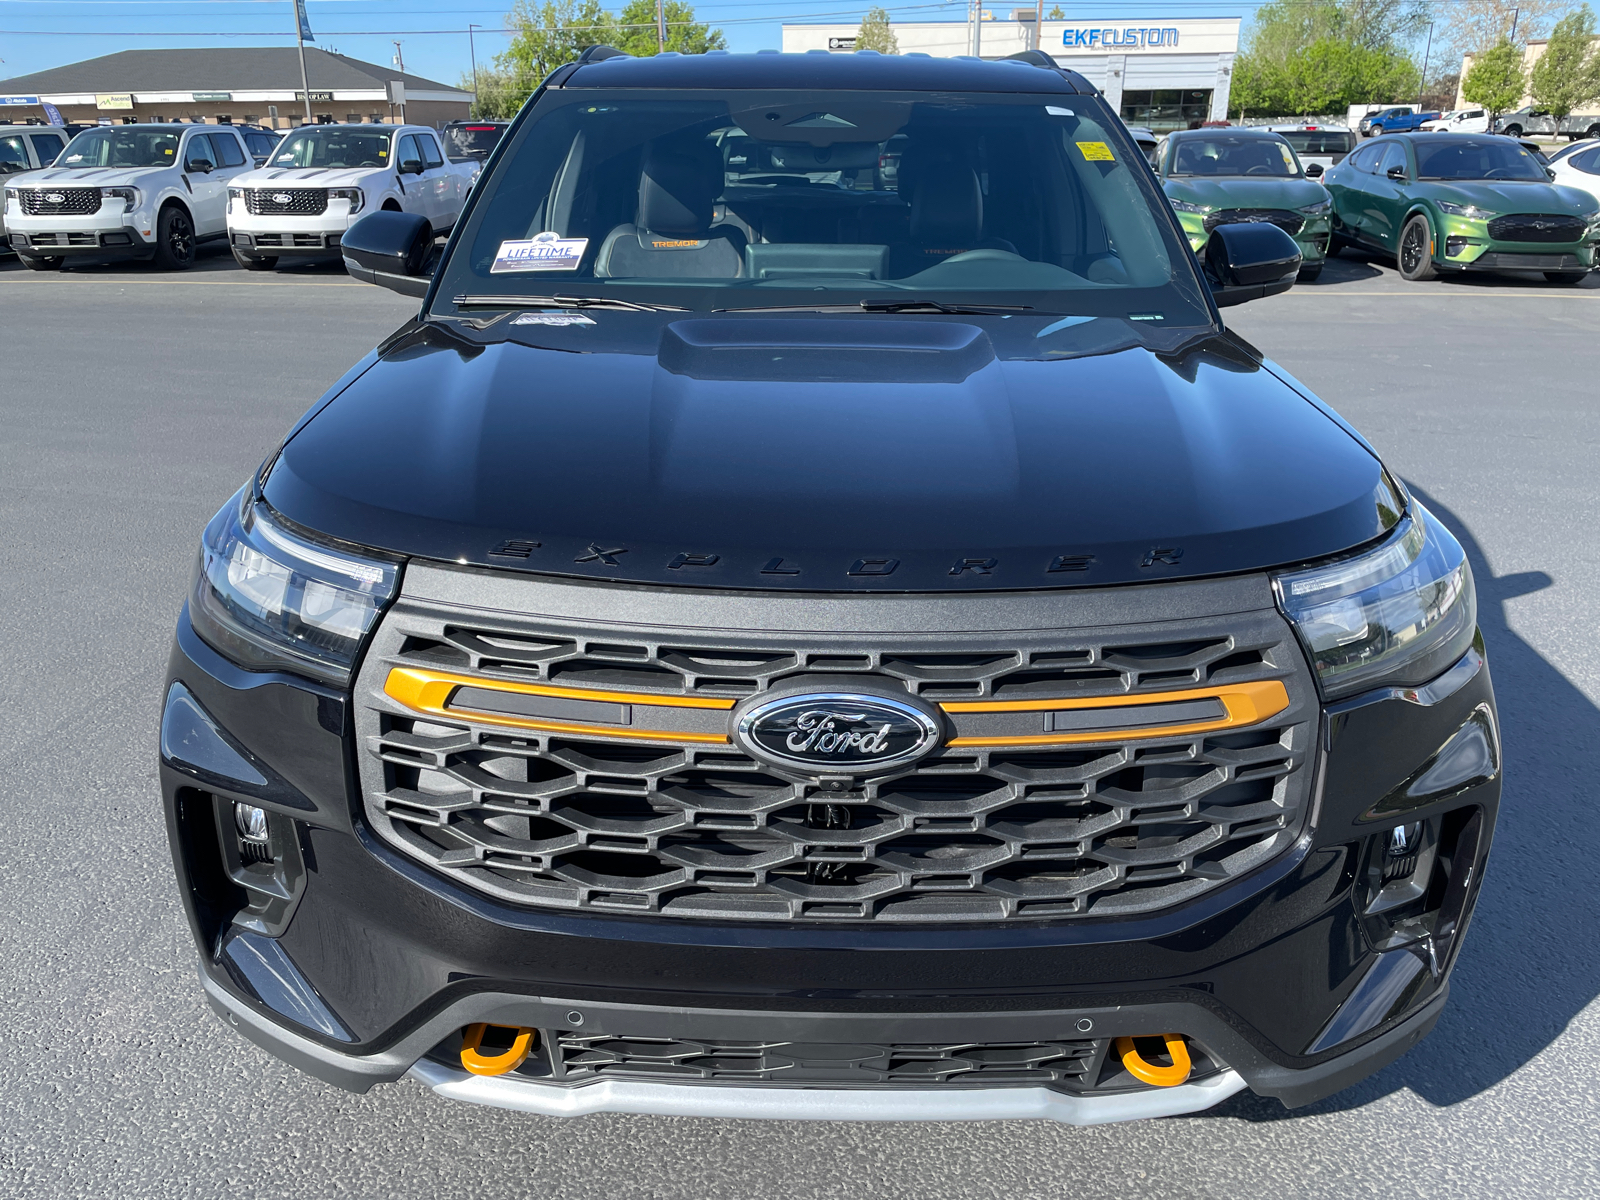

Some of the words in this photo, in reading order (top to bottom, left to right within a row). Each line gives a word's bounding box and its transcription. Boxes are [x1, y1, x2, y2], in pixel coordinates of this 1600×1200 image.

[508, 247, 574, 258] LIFETIME
[652, 240, 698, 248] TREMOR
[487, 538, 1184, 577] EXPLORER
[786, 711, 892, 753] Ford
